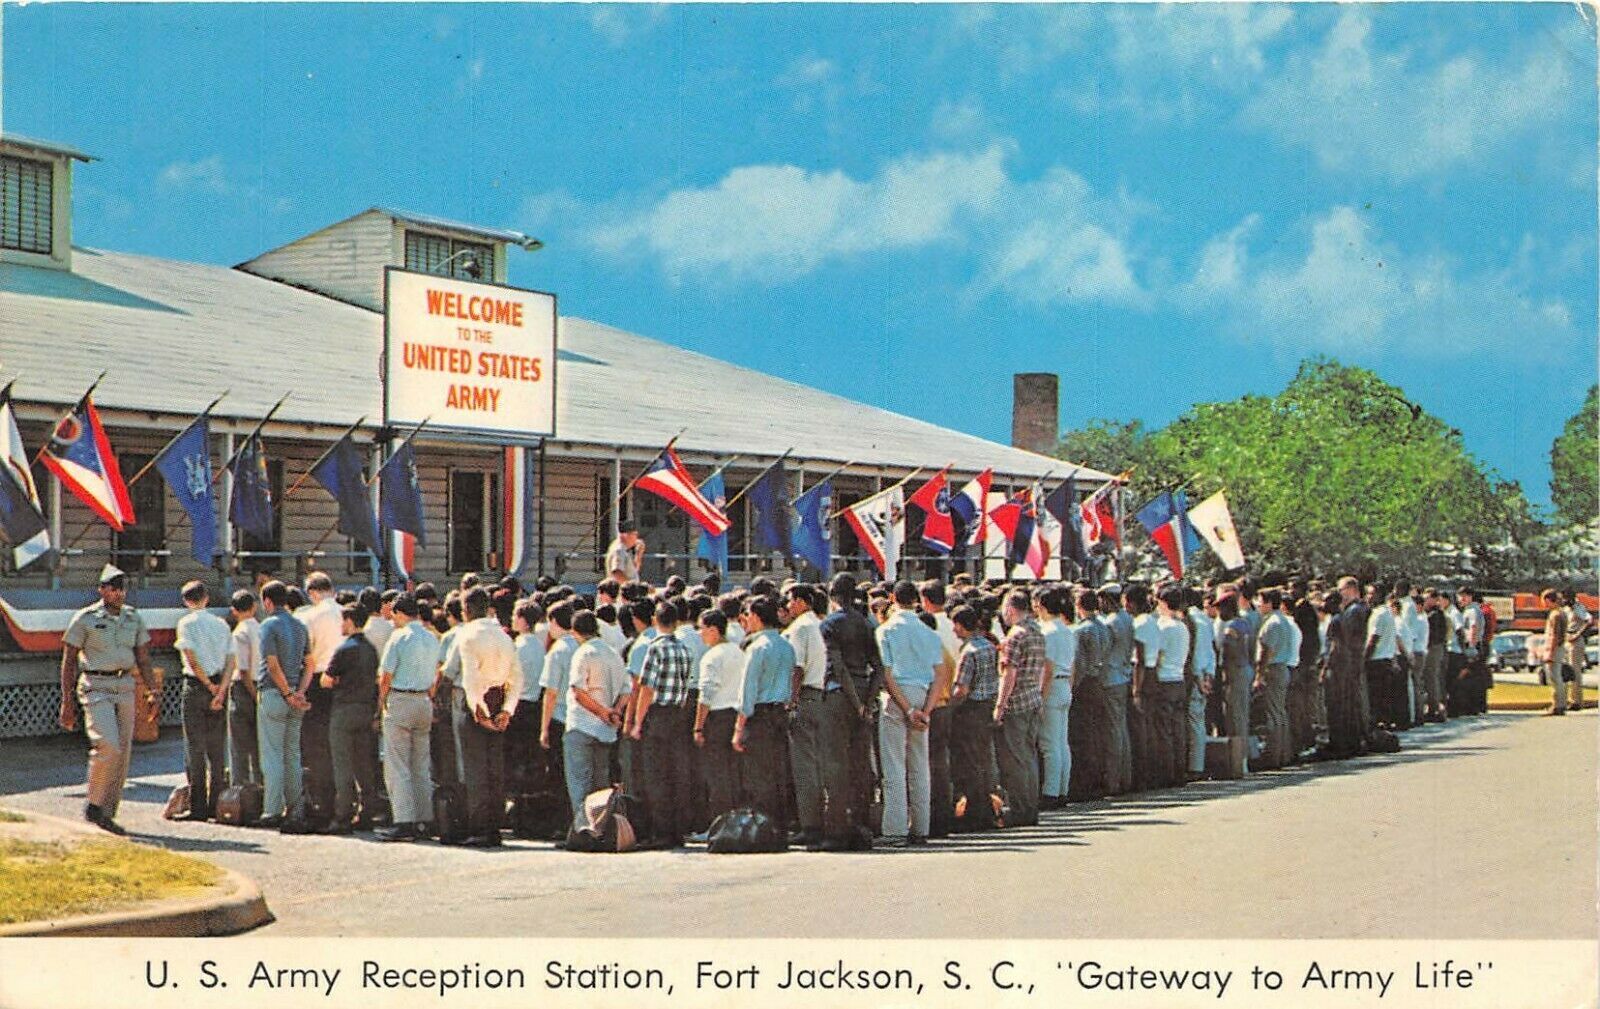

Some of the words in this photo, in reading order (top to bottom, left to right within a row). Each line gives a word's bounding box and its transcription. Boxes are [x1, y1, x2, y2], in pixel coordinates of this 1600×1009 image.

[426, 289, 524, 327] WELCOME
[457, 327, 471, 342] TO
[474, 328, 493, 344] THE
[403, 342, 473, 375] UNITED
[478, 351, 541, 383] STATES
[445, 384, 501, 413] ARMY
